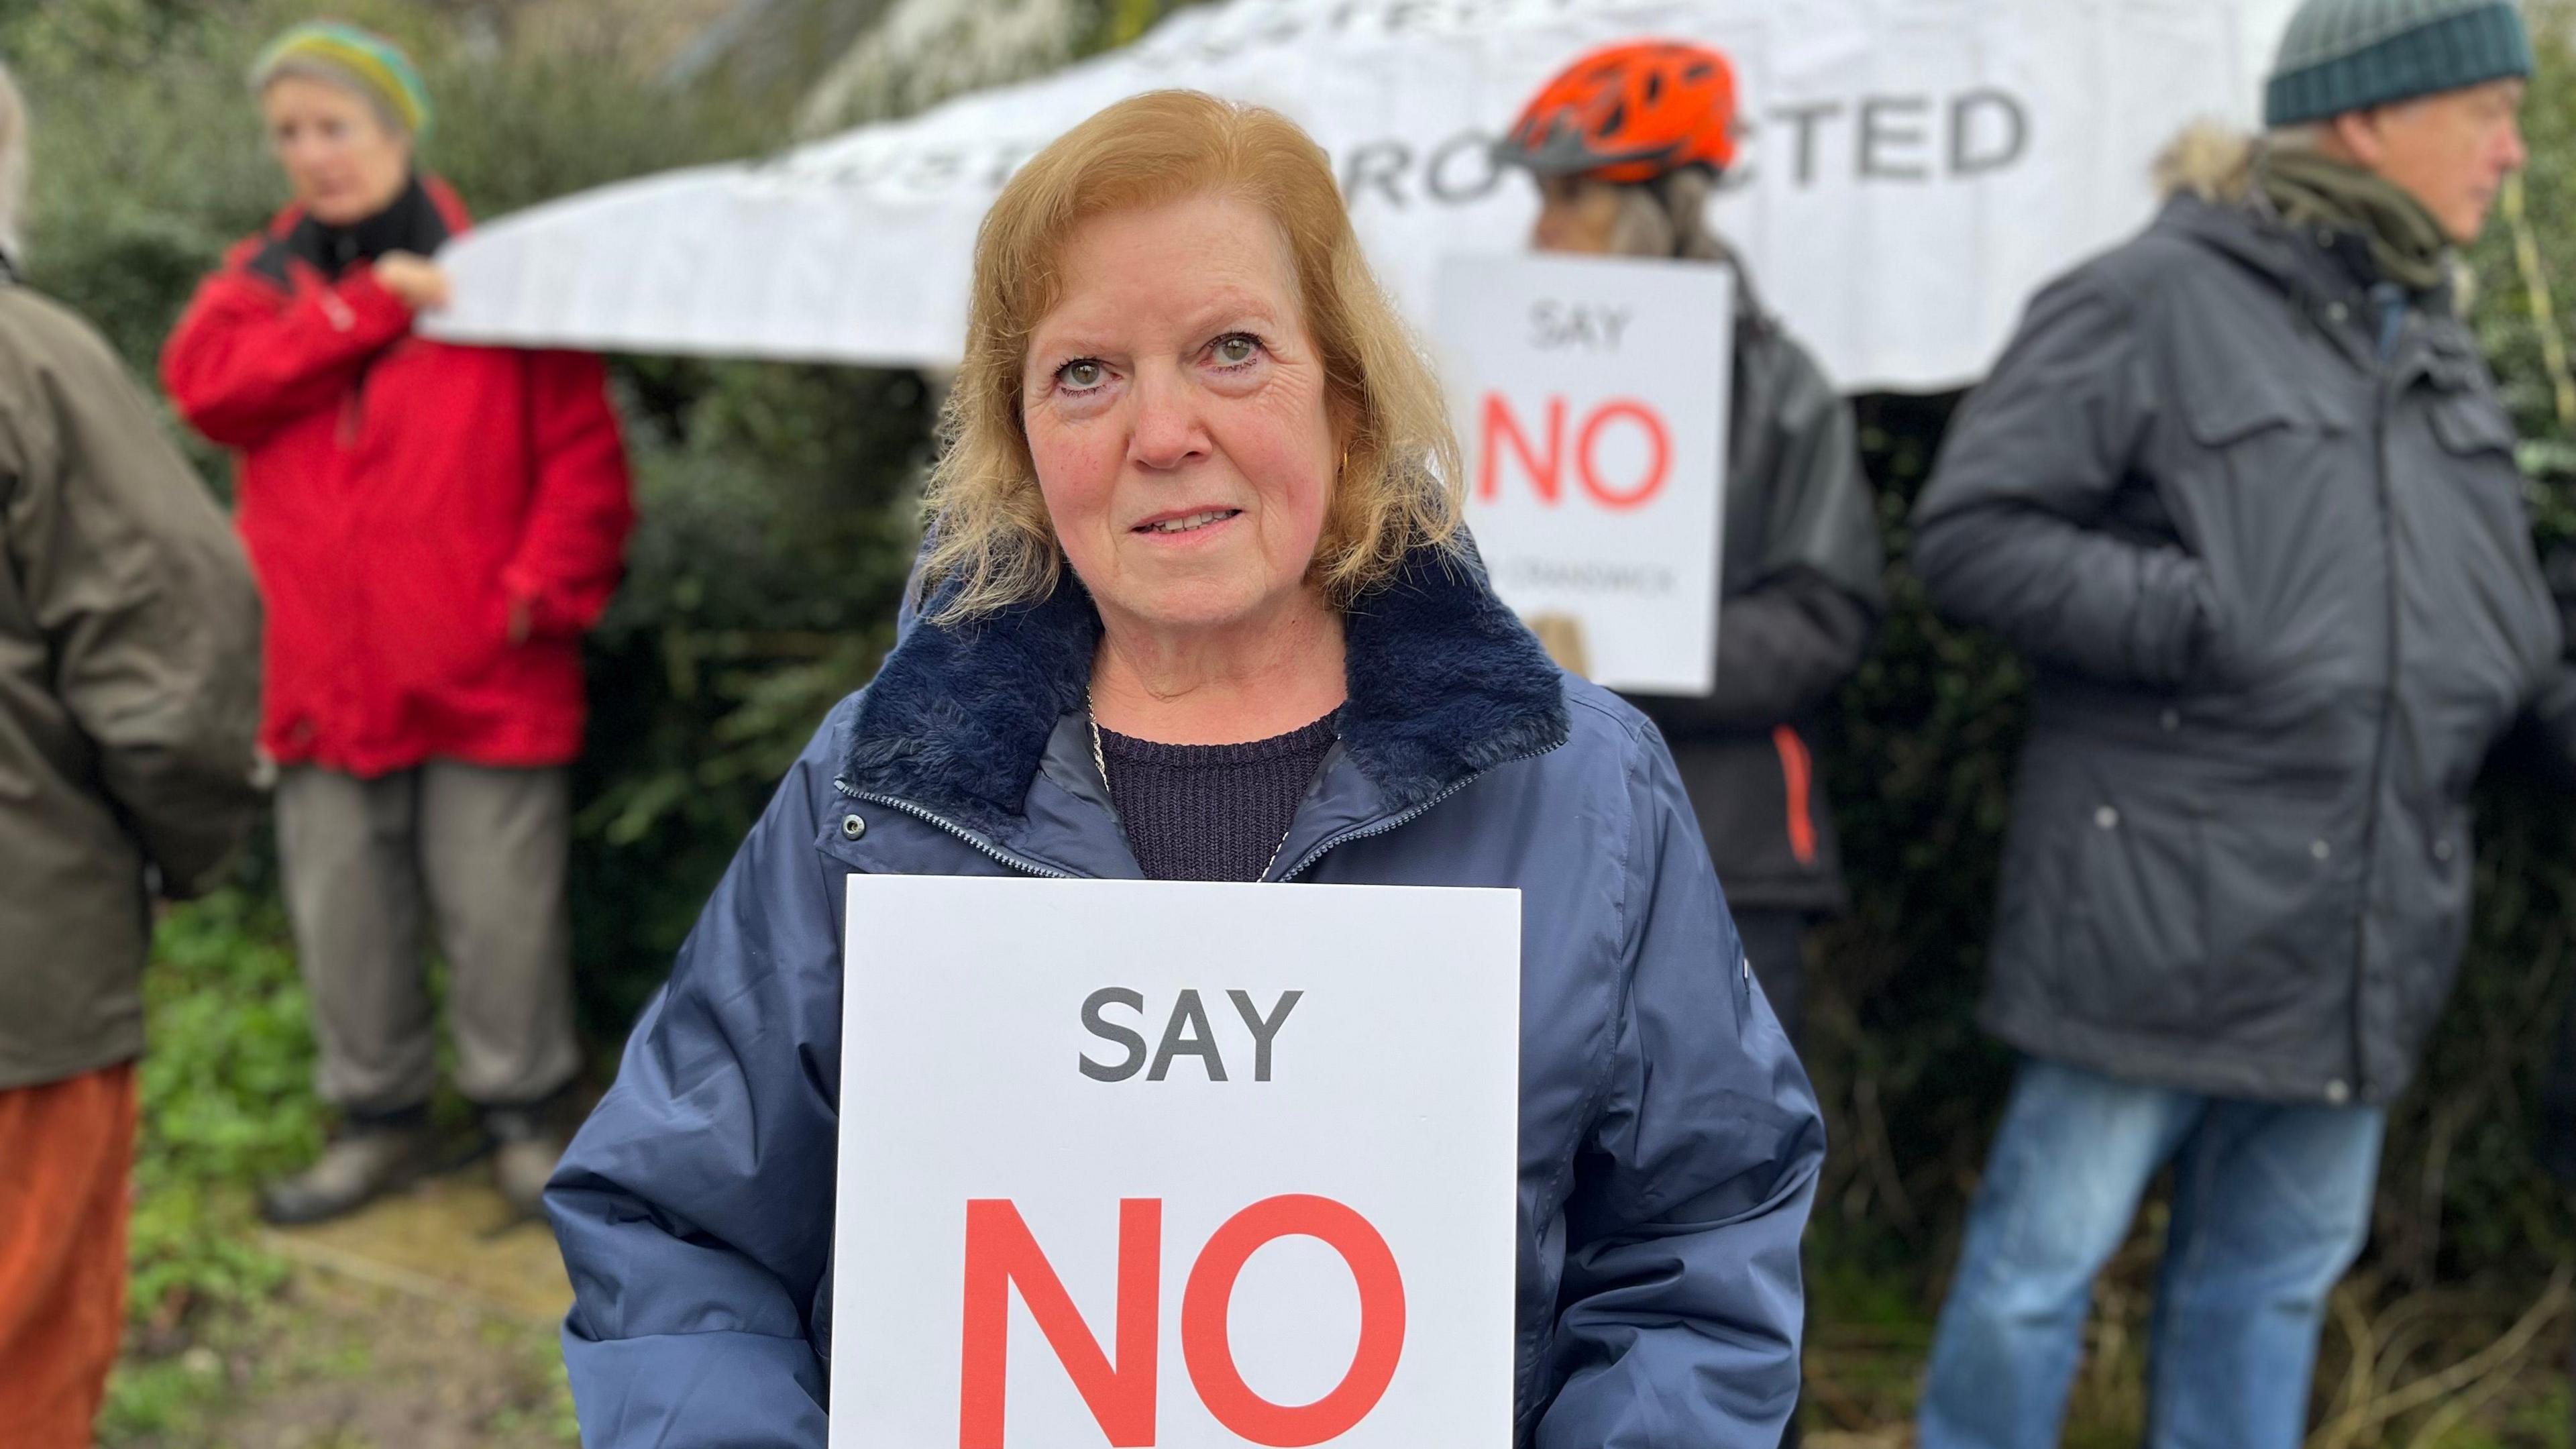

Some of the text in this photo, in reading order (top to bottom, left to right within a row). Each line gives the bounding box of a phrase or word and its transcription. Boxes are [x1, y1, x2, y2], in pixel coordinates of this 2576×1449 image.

[1528, 299, 1631, 352] SAY
[1477, 391, 1673, 513] NO
[1079, 987, 1303, 1082] SAY
[959, 1193, 1406, 1448] NO
